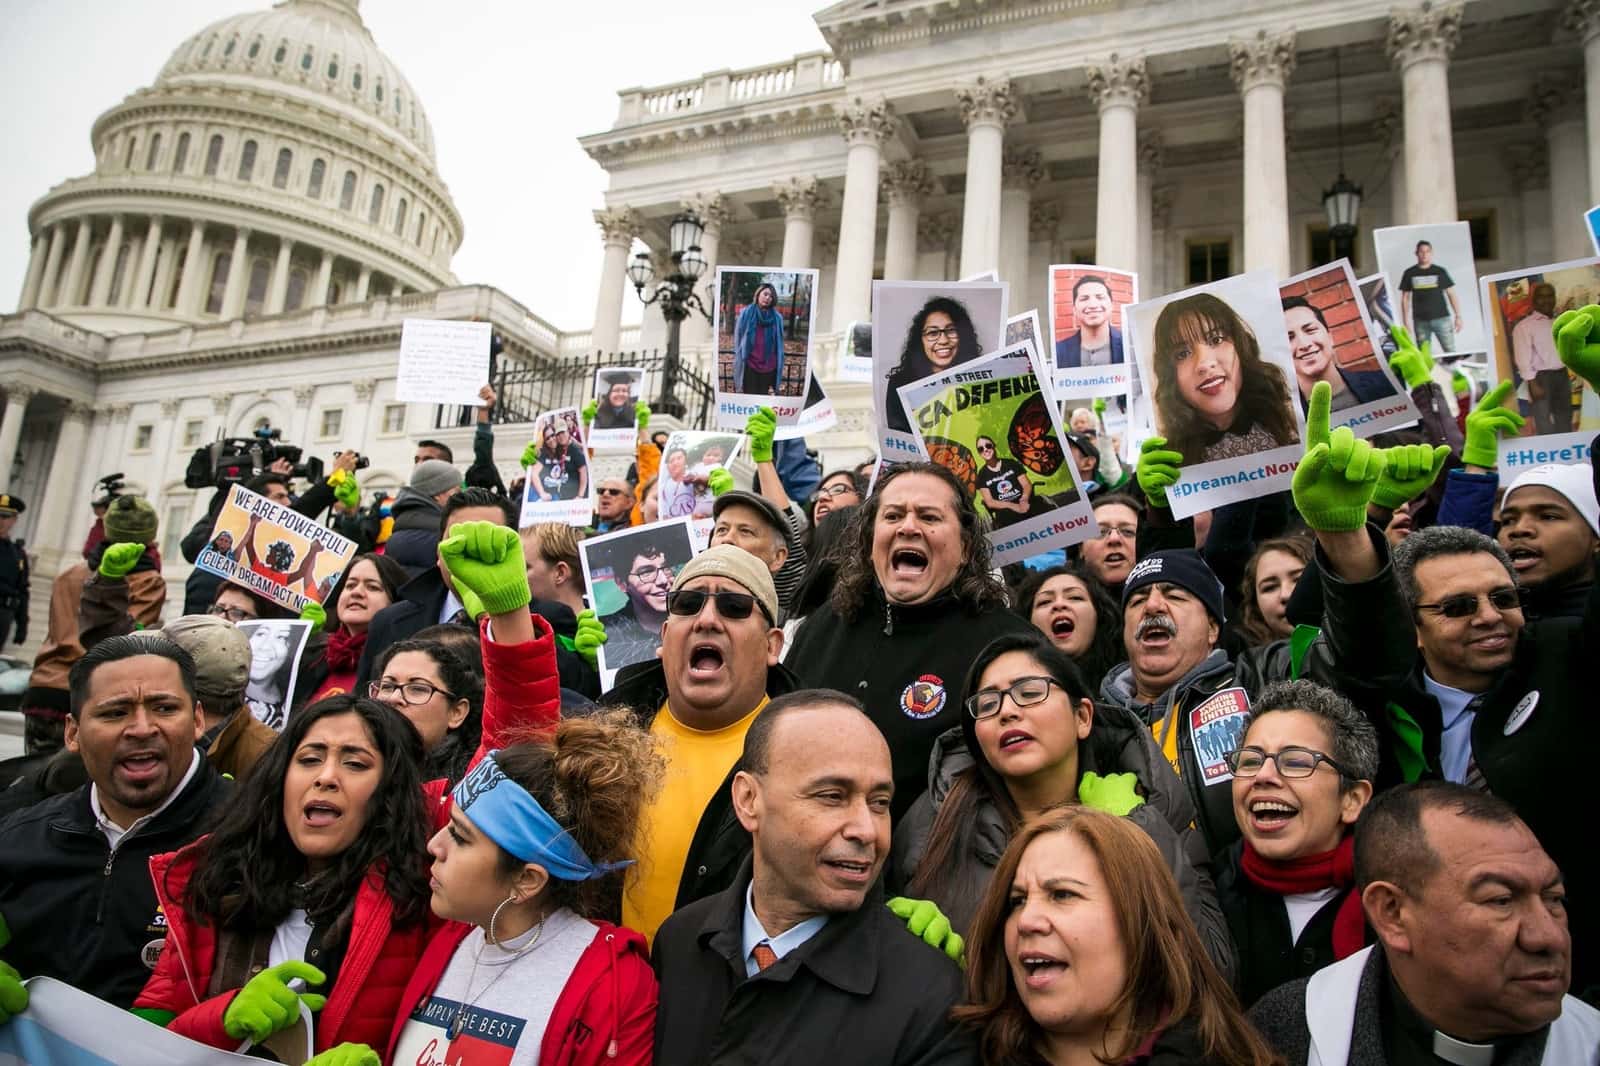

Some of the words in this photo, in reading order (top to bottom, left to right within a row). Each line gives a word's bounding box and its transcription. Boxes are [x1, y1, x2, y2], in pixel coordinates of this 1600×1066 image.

[955, 369, 993, 383] STREET
[720, 402, 799, 417] #HereTStay
[1331, 403, 1408, 432] ActNow
[885, 435, 921, 455] #He
[234, 488, 254, 514] WE
[252, 498, 279, 521] ARE
[993, 515, 1089, 552] eamActNow
[202, 551, 238, 575] CLEAN
[238, 567, 274, 594] DREAM
[273, 584, 294, 603] ACT
[293, 594, 313, 611] NO
[1200, 704, 1240, 724] UNITED
[460, 1008, 477, 1030] HE
[478, 1016, 517, 1041] BEST
